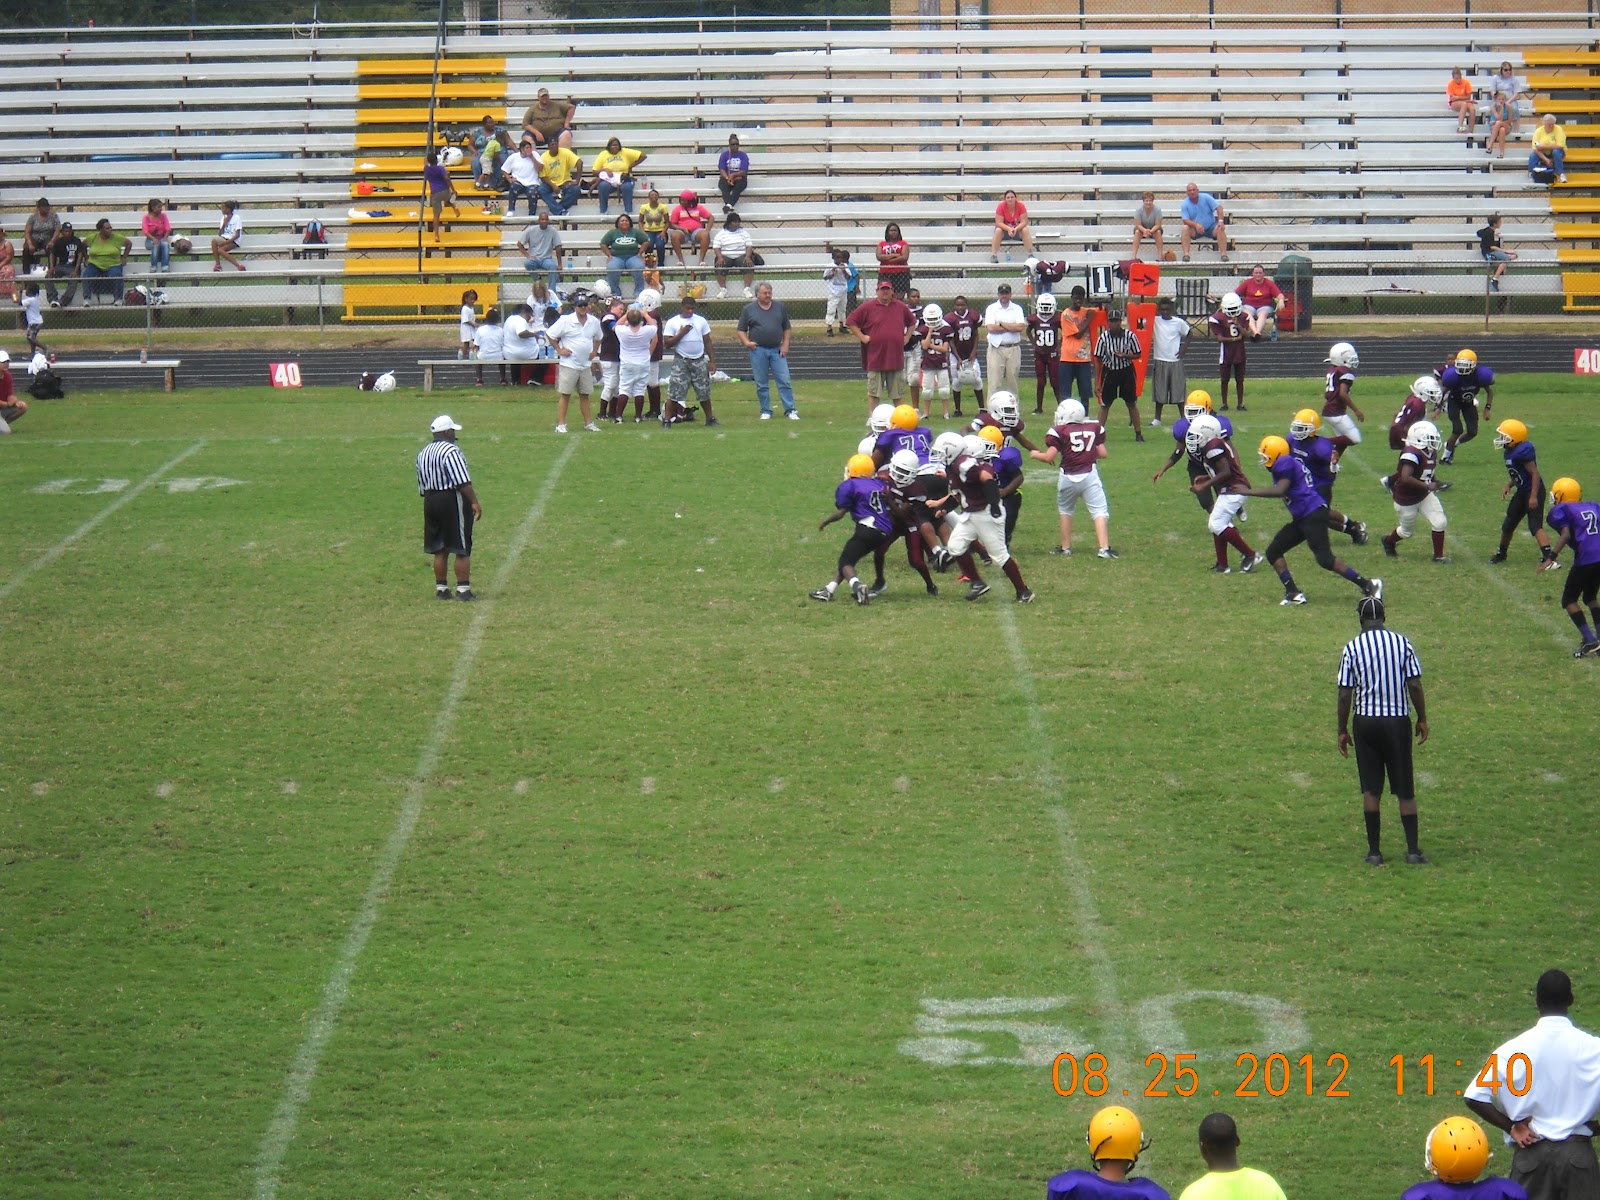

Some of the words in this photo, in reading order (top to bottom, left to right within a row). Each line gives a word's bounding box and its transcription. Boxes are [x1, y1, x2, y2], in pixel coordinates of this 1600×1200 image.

[1096, 267, 1108, 293] 1
[1036, 329, 1055, 347] 30
[1230, 323, 1239, 337] 6
[1577, 349, 1600, 373] 40
[274, 363, 301, 387] 40
[899, 434, 931, 454] 71
[1069, 430, 1096, 453] 57
[869, 490, 883, 514] 4
[1581, 510, 1598, 536] 7
[897, 990, 1313, 1067] 50
